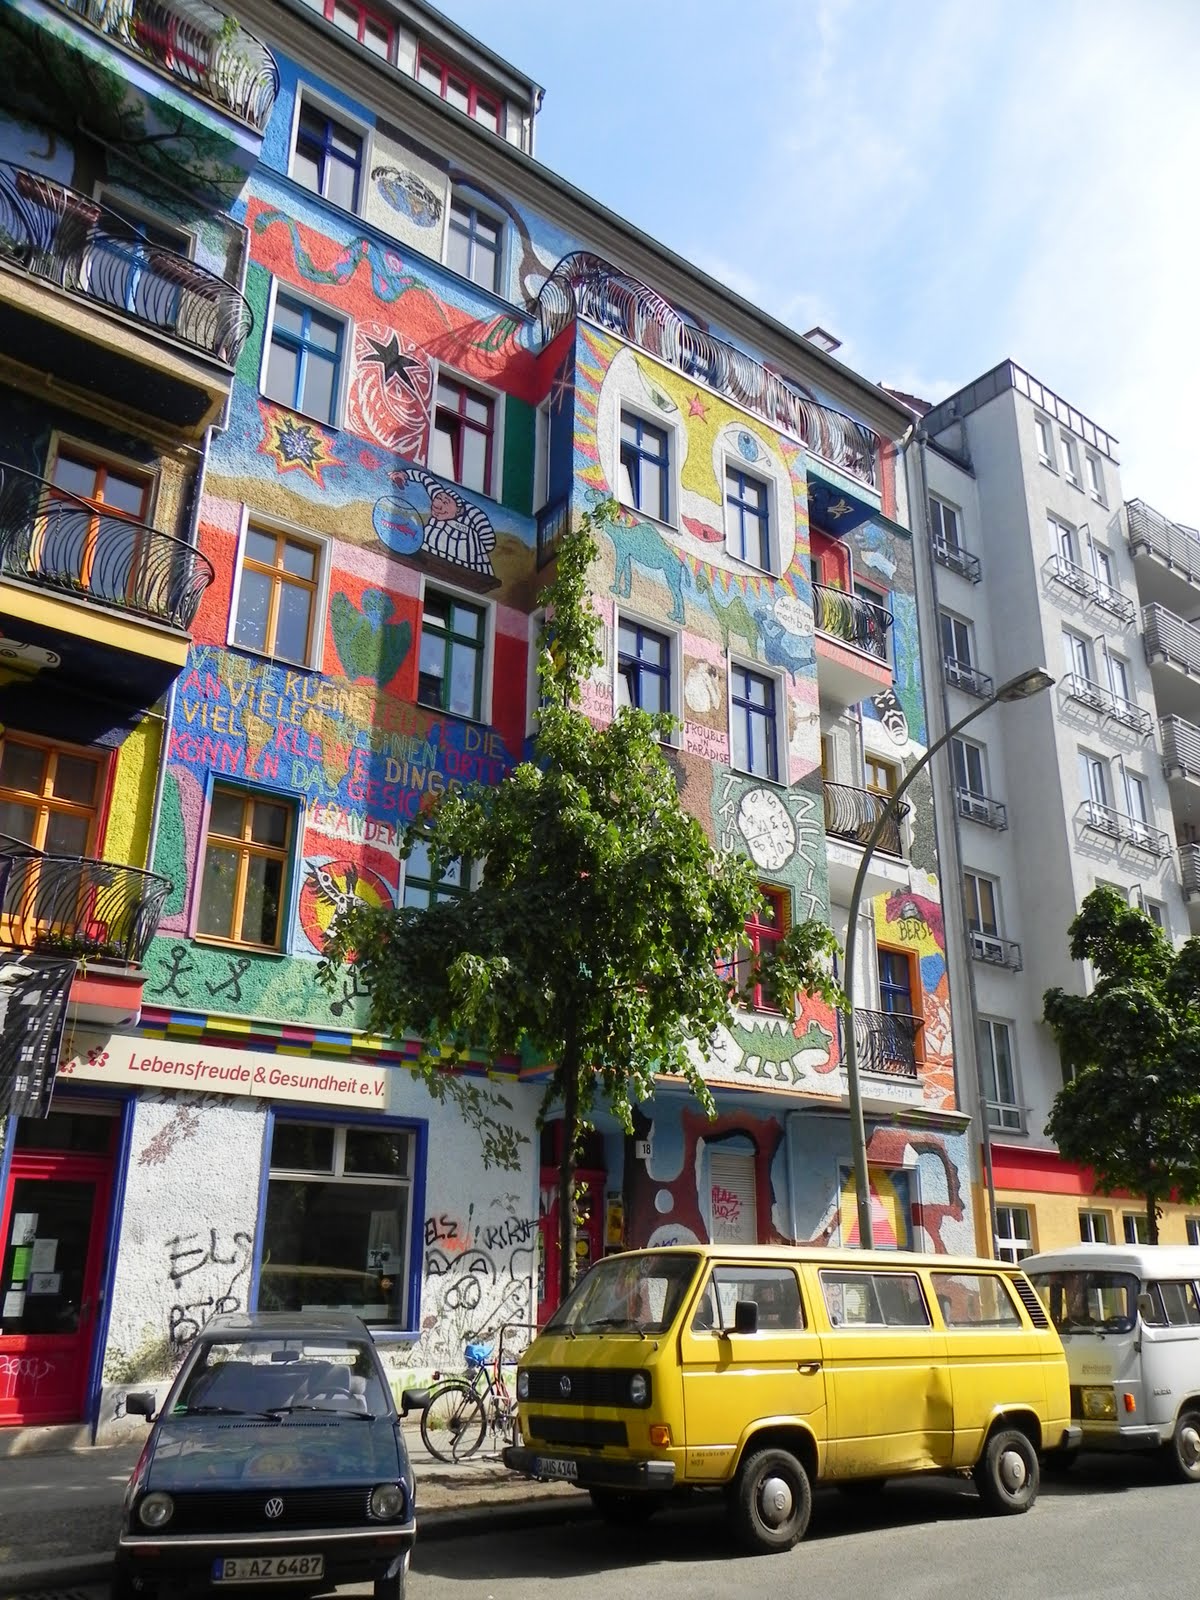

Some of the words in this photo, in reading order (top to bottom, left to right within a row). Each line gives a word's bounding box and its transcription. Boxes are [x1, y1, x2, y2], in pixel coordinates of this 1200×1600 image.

[182, 669, 221, 701] AN
[466, 725, 505, 760] DIE
[685, 720, 726, 744] TROUBLE
[686, 739, 730, 765] PARADISE
[291, 760, 338, 798] DAS
[716, 772, 743, 860] TRAU
[128, 1053, 251, 1082] Lebensfreude
[253, 1066, 267, 1085] &
[268, 1068, 358, 1094] Gesundheit
[359, 1080, 386, 1097] e.V.
[642, 1143, 651, 1155] 18
[224, 1561, 237, 1578] B
[249, 1560, 273, 1577] AZ
[276, 1557, 322, 1576] 6487
